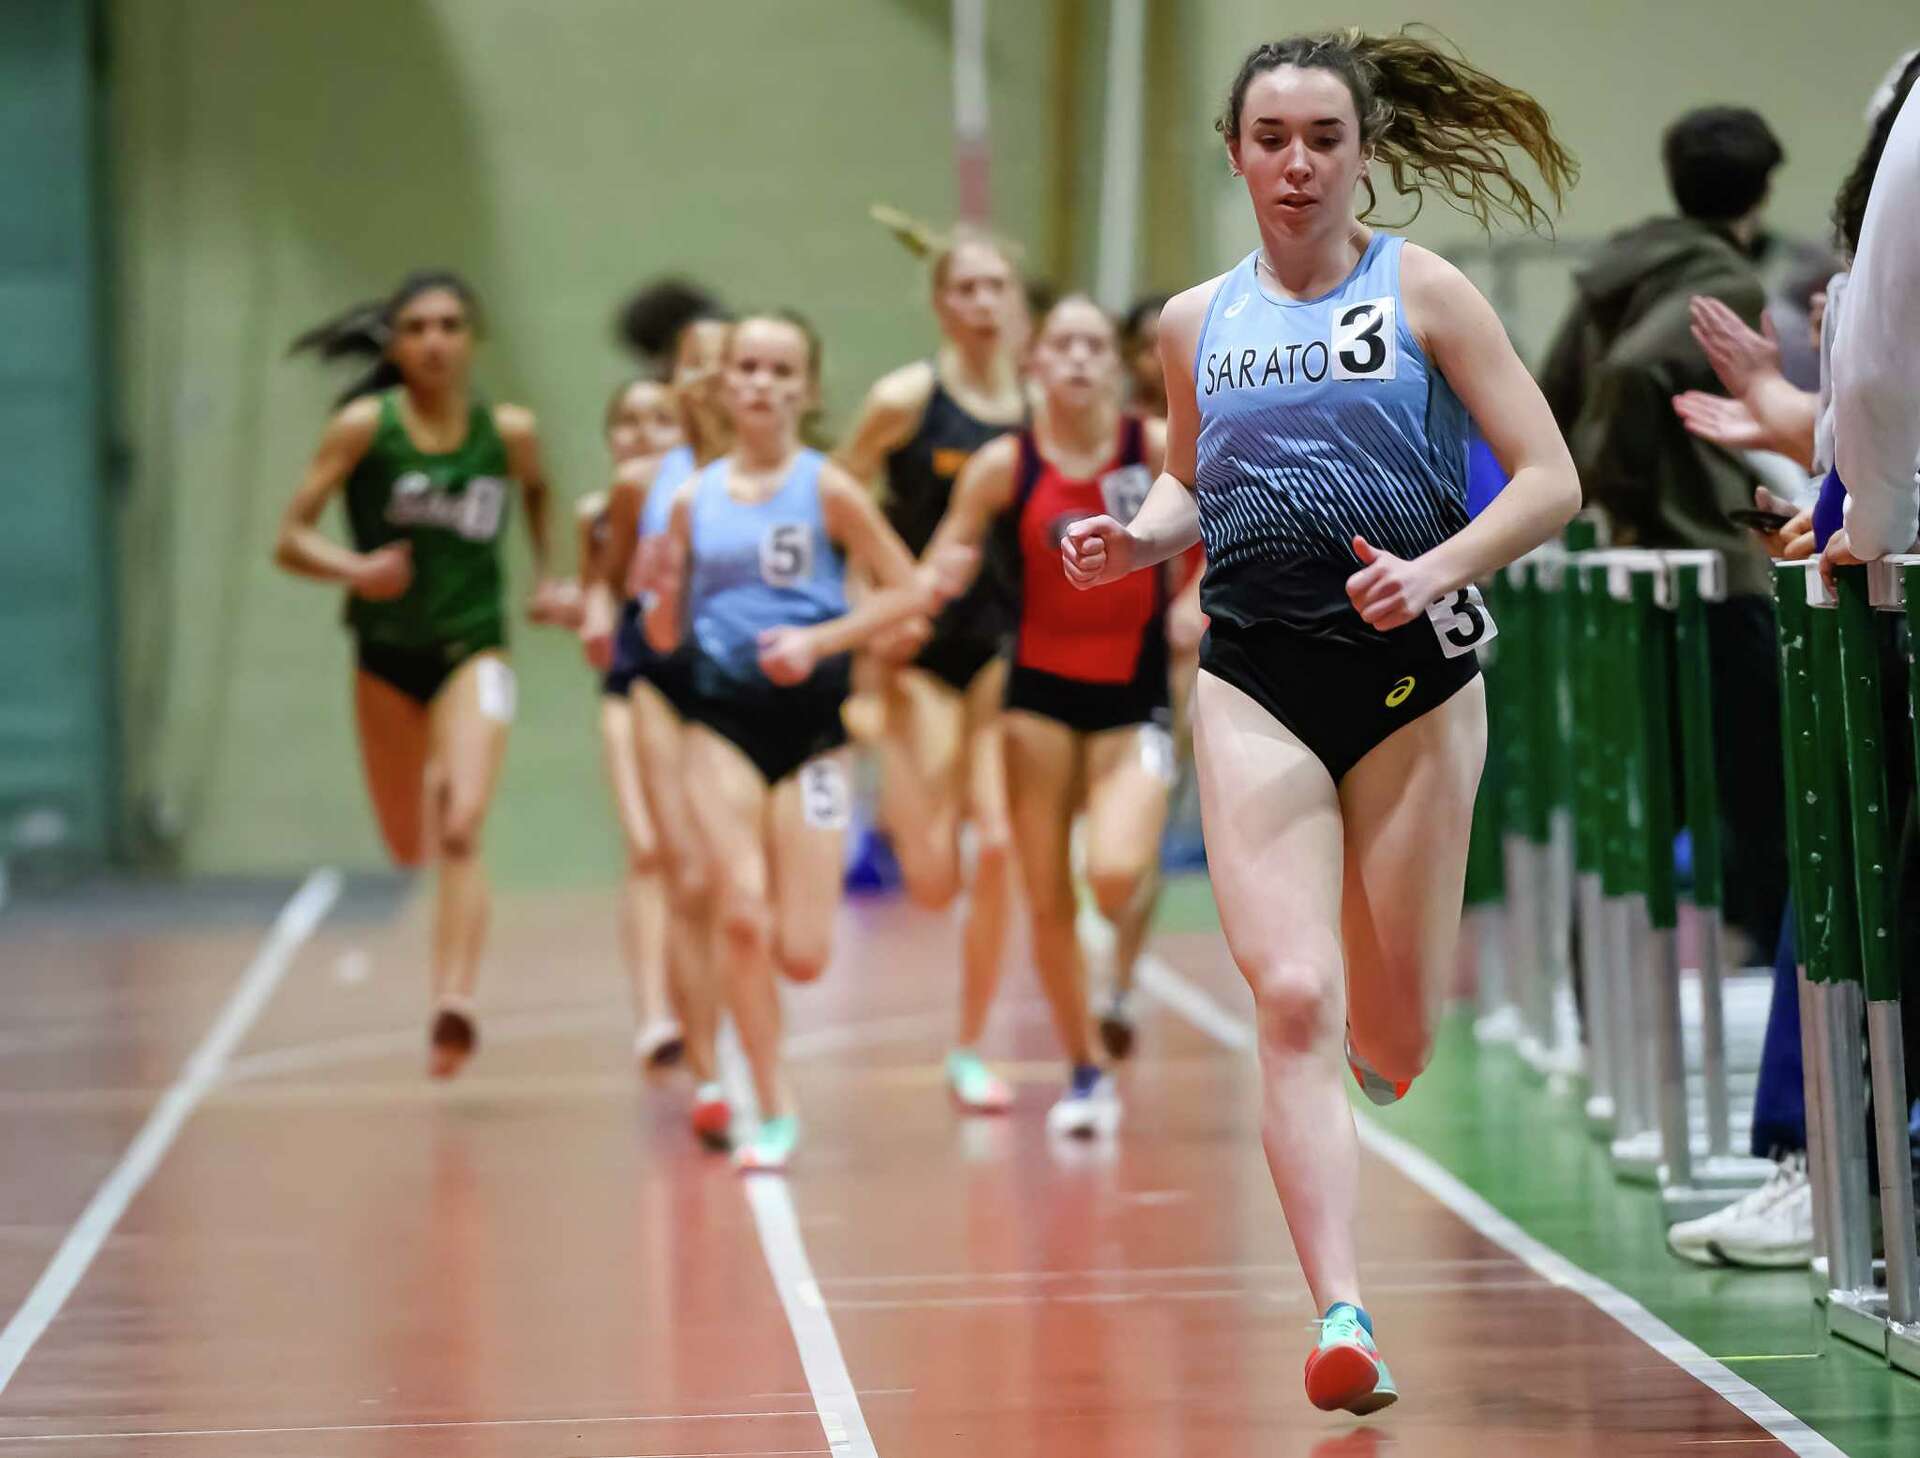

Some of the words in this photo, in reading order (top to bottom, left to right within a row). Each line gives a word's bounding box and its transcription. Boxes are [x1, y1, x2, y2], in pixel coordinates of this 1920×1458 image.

[1339, 304, 1387, 373] 3
[1204, 340, 1385, 396] SARATO
[774, 526, 810, 577] 5
[1432, 588, 1485, 647] 3
